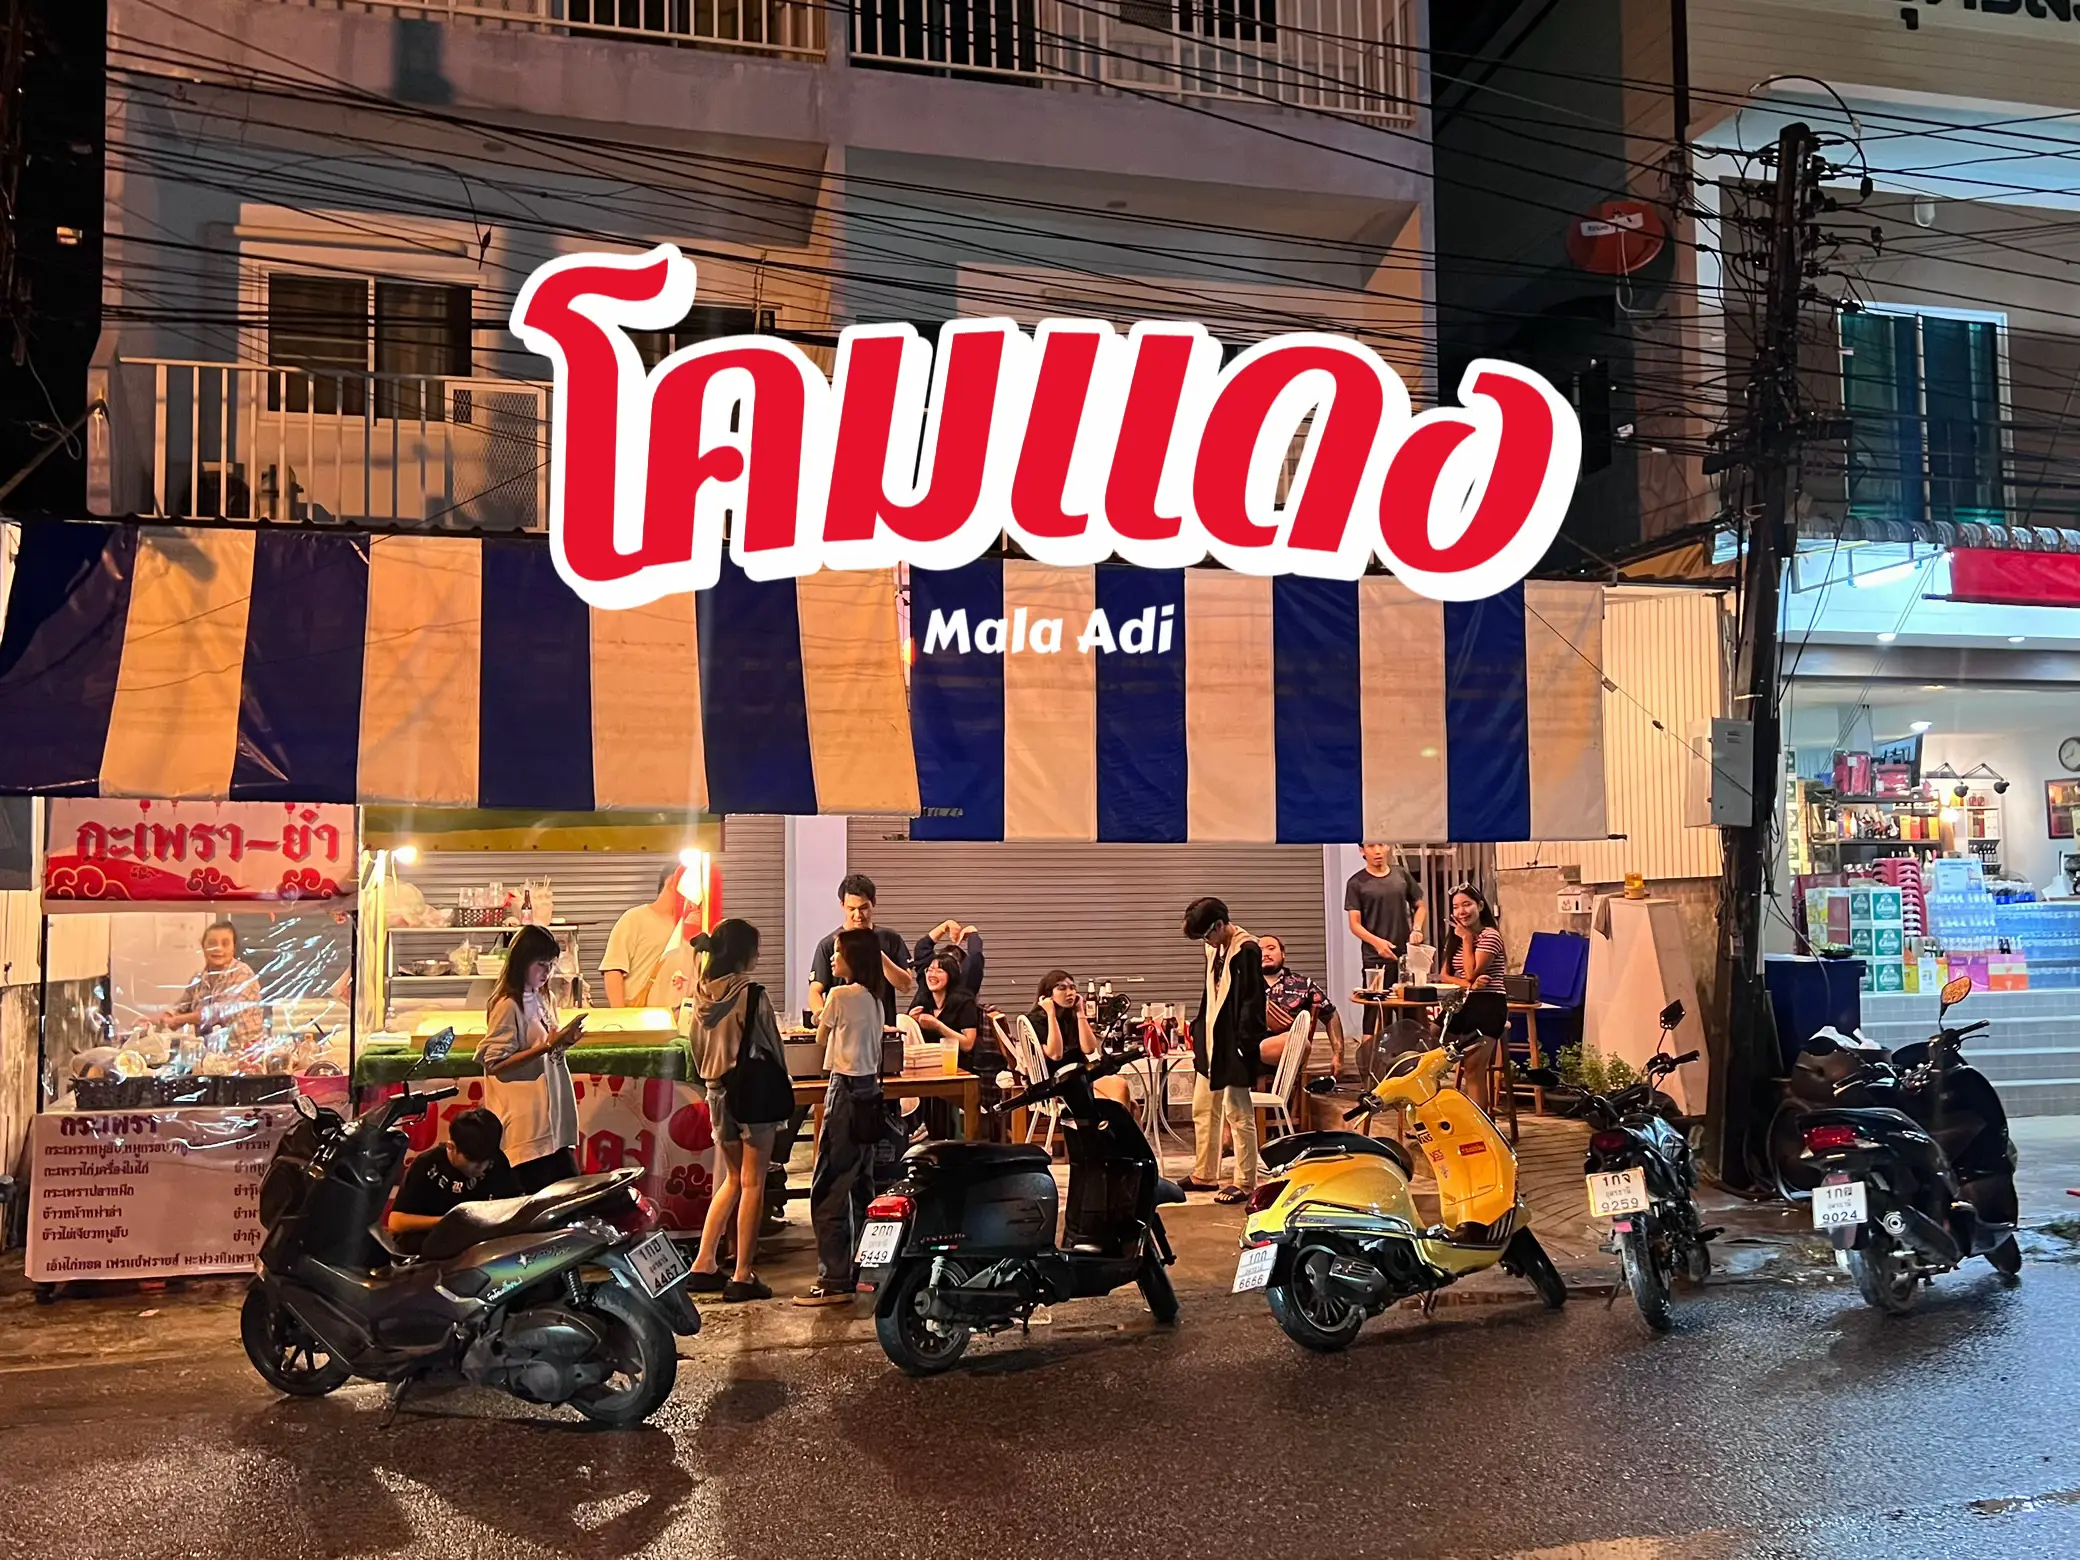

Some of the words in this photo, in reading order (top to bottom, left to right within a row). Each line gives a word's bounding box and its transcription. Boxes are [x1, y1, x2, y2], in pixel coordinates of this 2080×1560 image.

[1602, 1173, 1631, 1187] 1กจ
[1601, 1197, 1639, 1213] 9259
[1822, 1209, 1858, 1224] 9024
[860, 1250, 889, 1262] 5449
[654, 1263, 679, 1290] 4467
[1238, 1274, 1264, 1289] 6666
